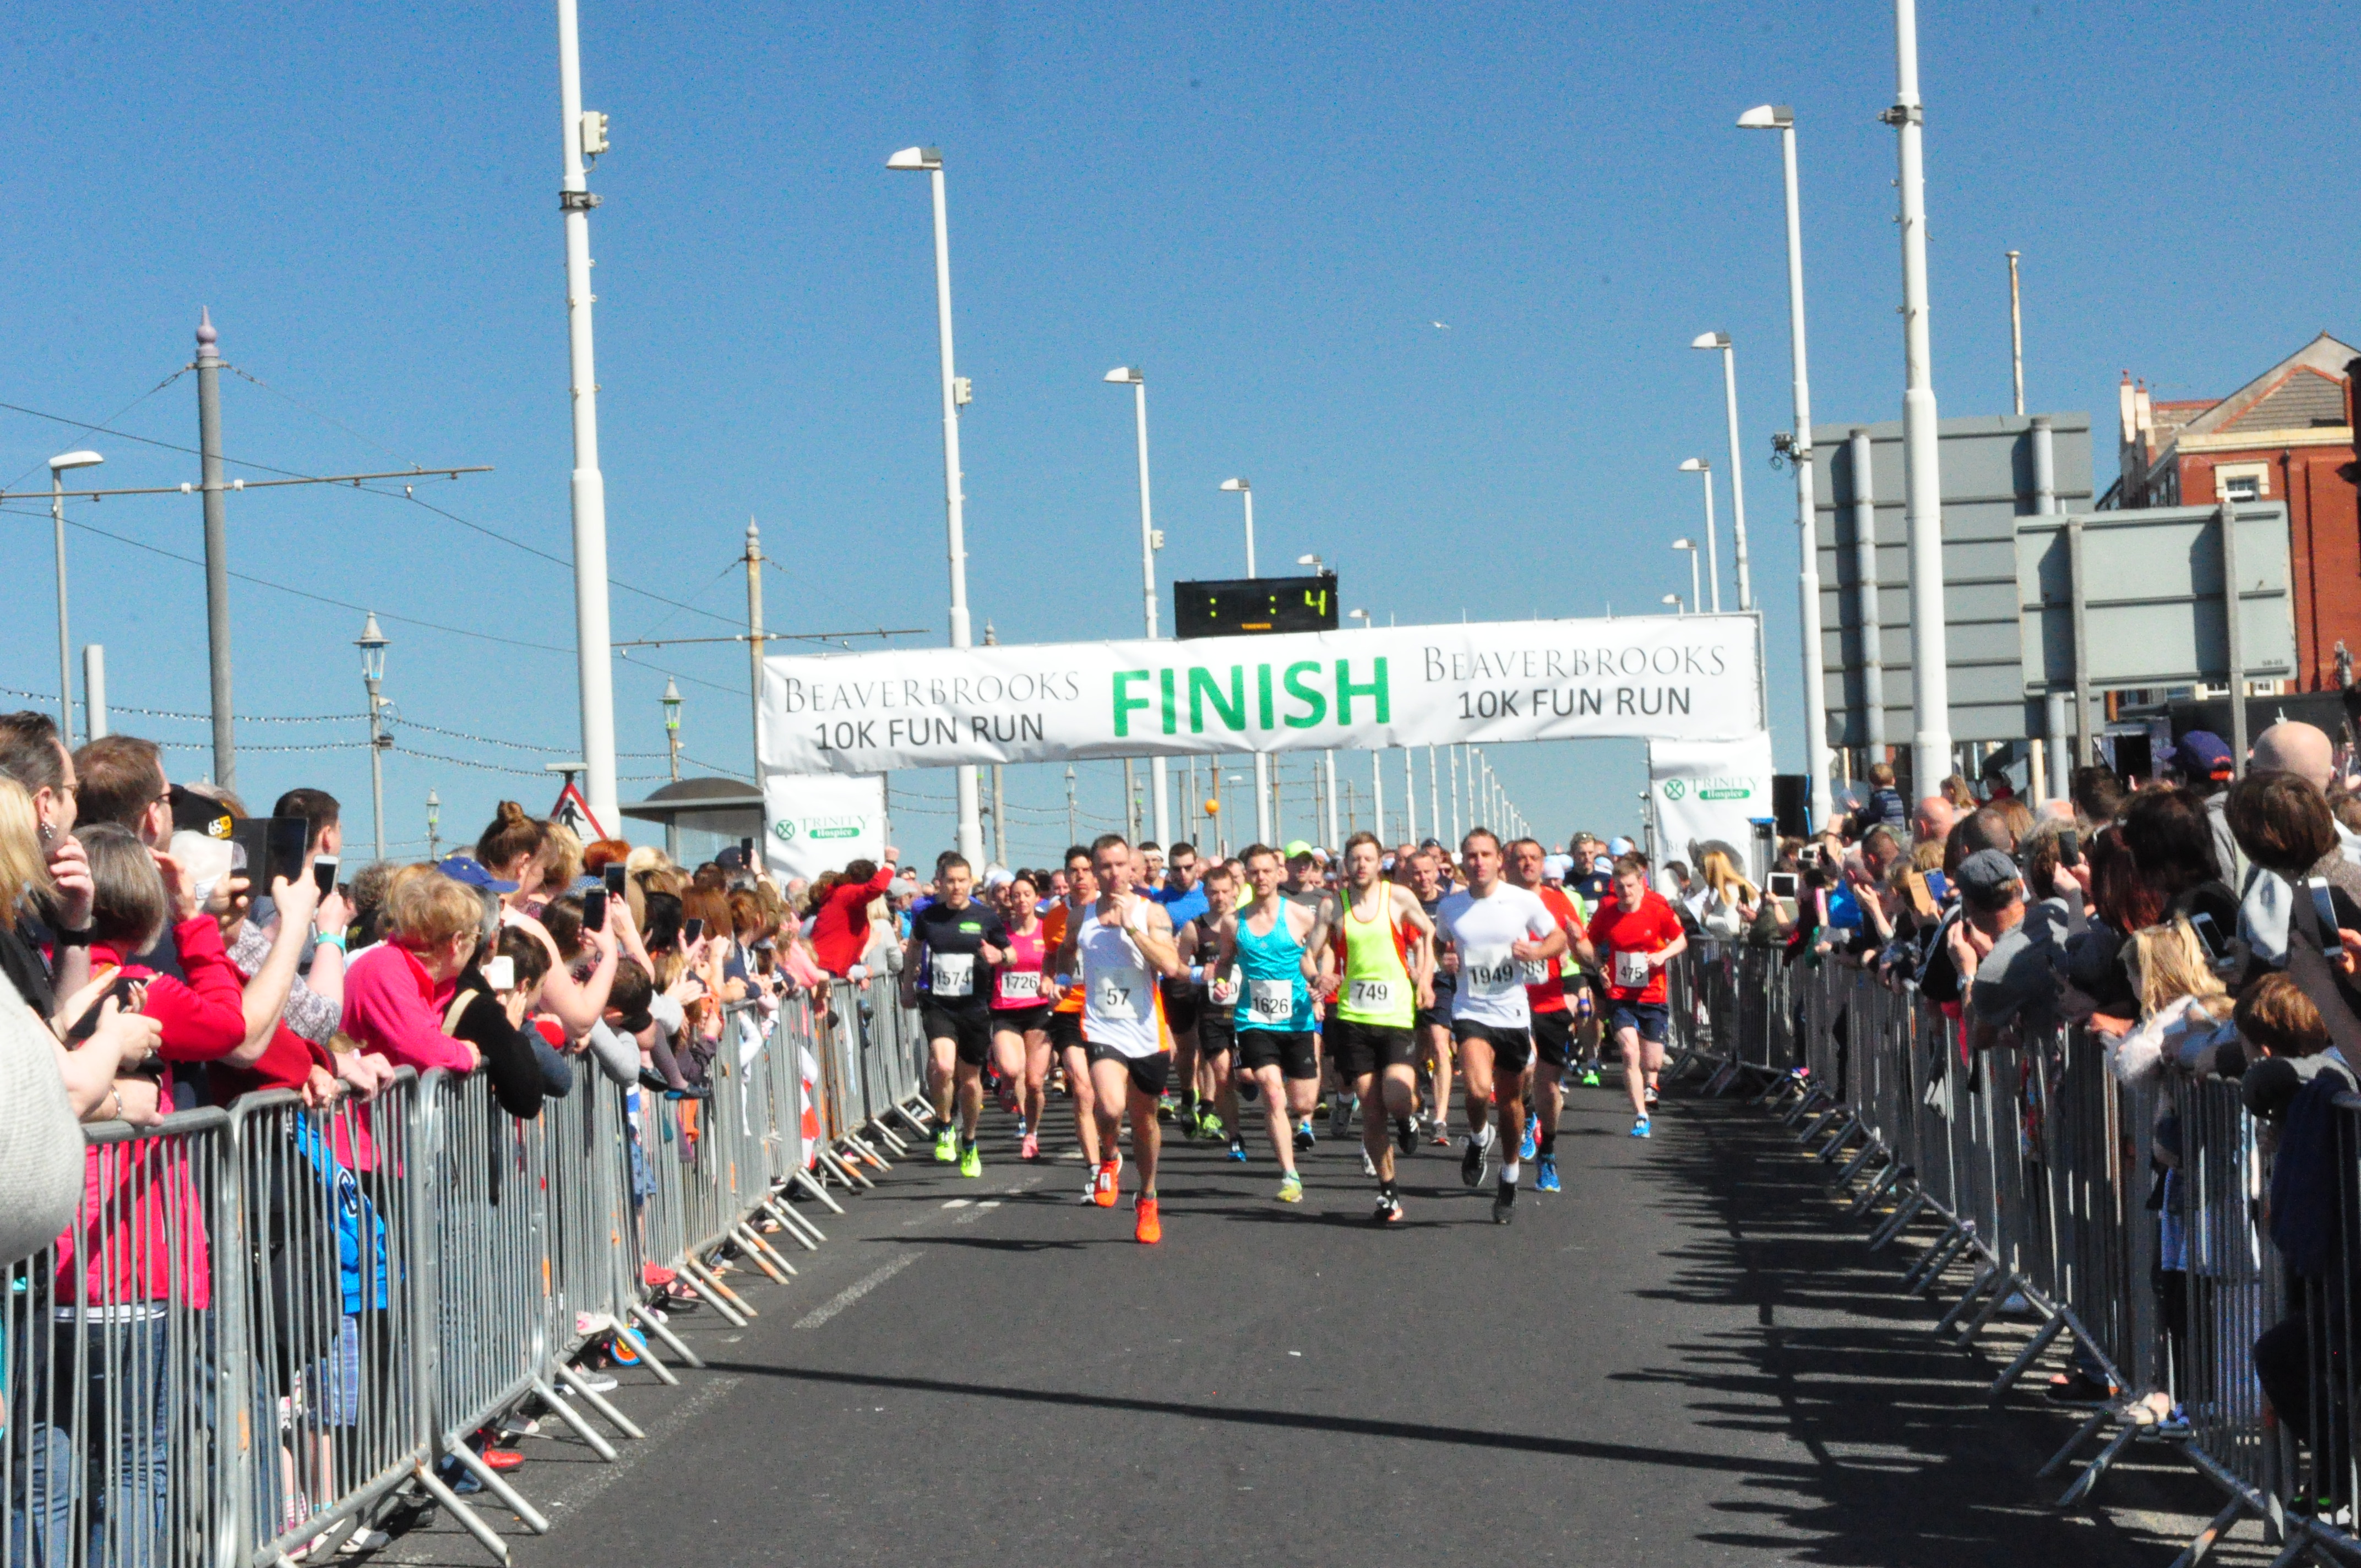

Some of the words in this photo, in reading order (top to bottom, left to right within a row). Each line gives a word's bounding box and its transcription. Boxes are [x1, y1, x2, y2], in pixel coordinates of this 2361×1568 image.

[1423, 645, 1726, 683] BEAVERBROOKS
[785, 670, 1080, 714] BEAVERBROOKS
[1113, 656, 1390, 738] FINISH
[1459, 688, 1520, 720] 10K
[1532, 688, 1602, 716] FUN
[1617, 687, 1690, 715] RUN
[816, 721, 877, 750] 10K
[890, 717, 958, 747] FUN
[972, 714, 1044, 743] RUN
[1689, 776, 1760, 793] TRINITY
[1706, 789, 1743, 799] Hospice
[798, 815, 871, 832] TRINITY
[817, 827, 853, 838] Hospice
[937, 970, 971, 986] 1574
[1468, 963, 1514, 984] 1949
[1620, 966, 1643, 979] 475
[1005, 975, 1037, 989] 1726
[1107, 988, 1130, 1005] 57
[1356, 982, 1388, 1001] 749
[1253, 997, 1288, 1014] 1626
